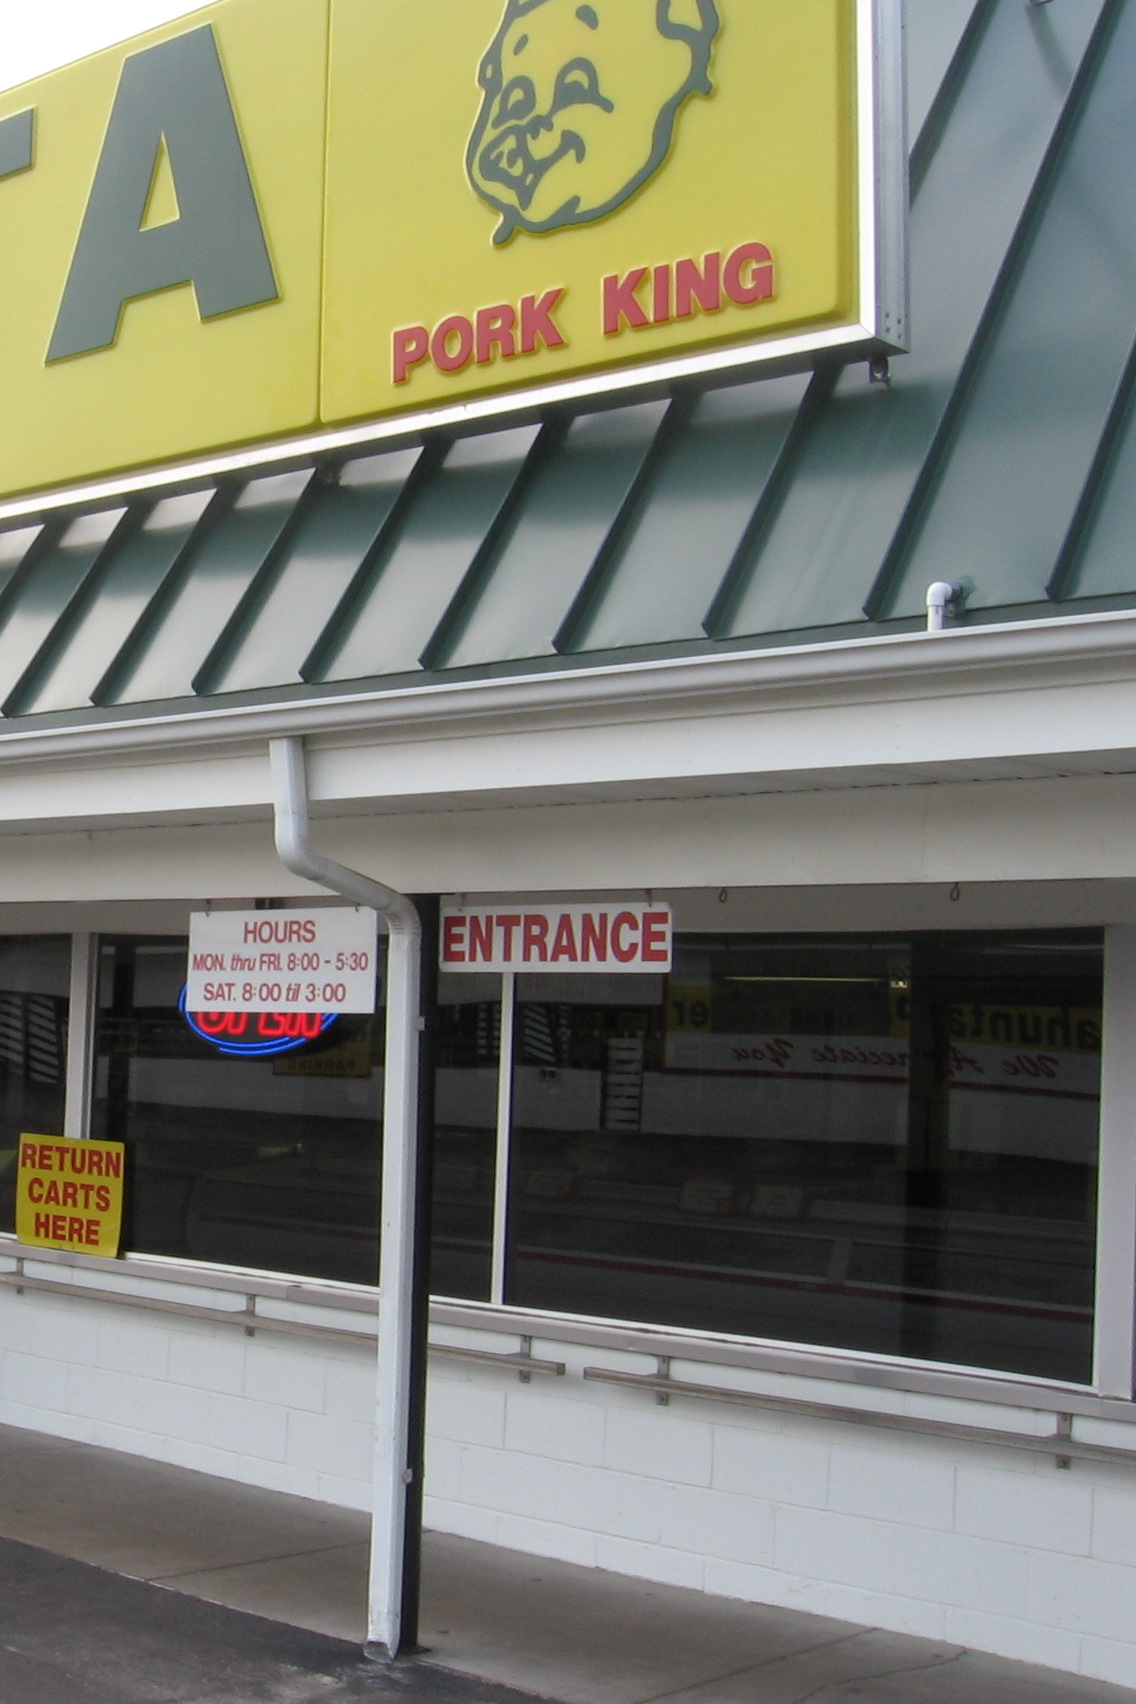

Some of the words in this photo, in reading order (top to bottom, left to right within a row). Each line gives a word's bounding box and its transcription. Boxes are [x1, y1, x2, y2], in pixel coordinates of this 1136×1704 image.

[392, 287, 566, 386] PORK
[602, 241, 775, 336] KING
[243, 919, 317, 944] HOURS
[442, 911, 669, 963] ENTRANCE
[192, 953, 227, 972] MON.
[230, 953, 256, 972] thru
[259, 953, 282, 972] FRI.
[287, 952, 320, 971] 8:00
[335, 952, 369, 971] 5:30
[203, 982, 237, 1002] SAT.
[242, 982, 282, 1002] 8:00
[285, 982, 302, 1002] til
[305, 982, 347, 1003] 3:00
[21, 1143, 121, 1178] RETURN
[28, 1177, 111, 1212] CARTS
[34, 1212, 101, 1246] HERE
